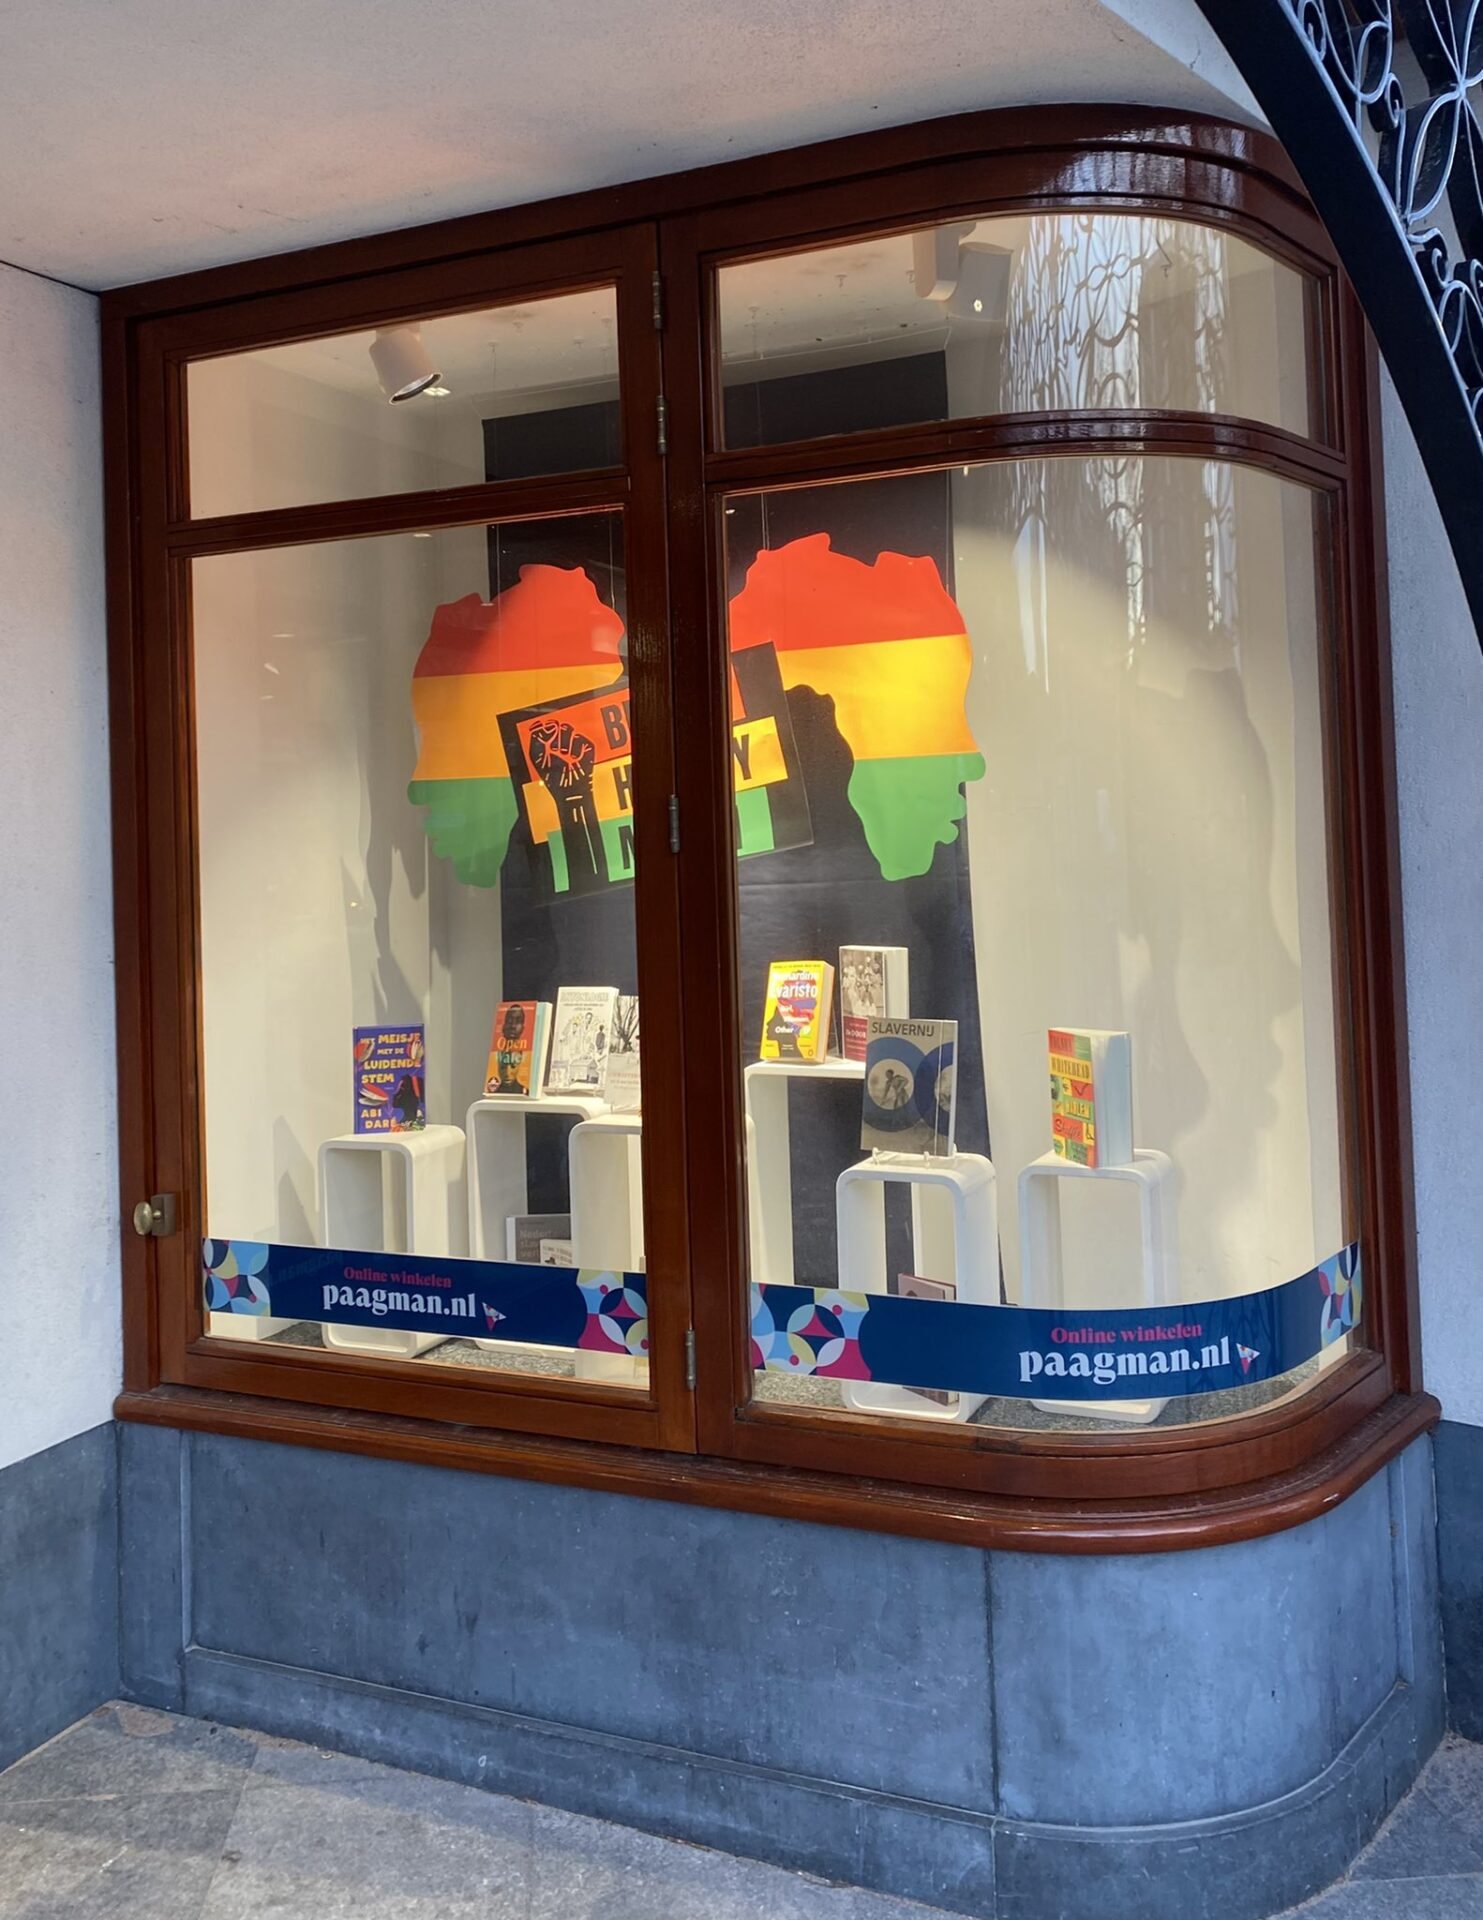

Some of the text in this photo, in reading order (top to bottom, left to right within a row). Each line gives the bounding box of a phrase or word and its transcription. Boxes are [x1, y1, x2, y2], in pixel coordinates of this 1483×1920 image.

[378, 1033, 420, 1044] MEISJE
[497, 1036, 527, 1052] Open
[364, 1058, 421, 1069] LUIDENDE
[361, 1073, 394, 1084] STEM
[361, 1109, 382, 1118] ABI
[343, 1266, 388, 1283] Online
[391, 1271, 452, 1288] winkelen
[322, 1284, 476, 1317] paagman.nl
[1051, 1323, 1202, 1344] Online winkelen
[1019, 1335, 1230, 1385] paagman.nl
